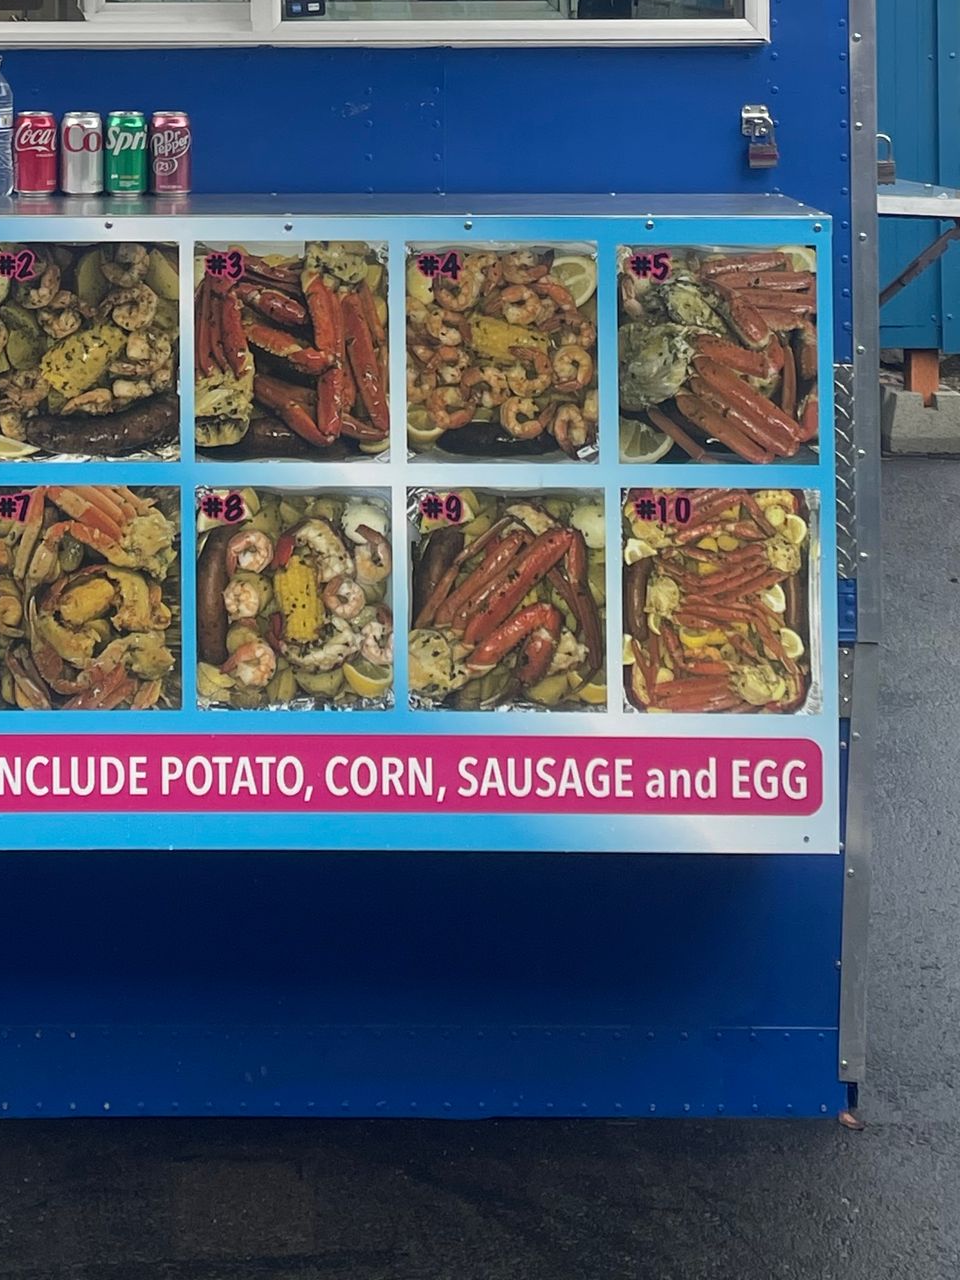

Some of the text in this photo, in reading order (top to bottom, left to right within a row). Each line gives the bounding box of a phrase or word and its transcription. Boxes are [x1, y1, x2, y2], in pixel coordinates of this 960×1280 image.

[152, 134, 188, 157] Pepper
[206, 253, 243, 280] #3
[418, 254, 461, 280] #4
[630, 254, 669, 280] #5
[201, 494, 244, 522] #8
[420, 495, 462, 521] #9
[635, 497, 691, 523] #10
[161, 755, 314, 802] POTATO,
[325, 756, 446, 803] CORN,
[458, 756, 634, 799] SAUSAGE
[645, 757, 717, 799] and
[733, 759, 808, 800] EGG
